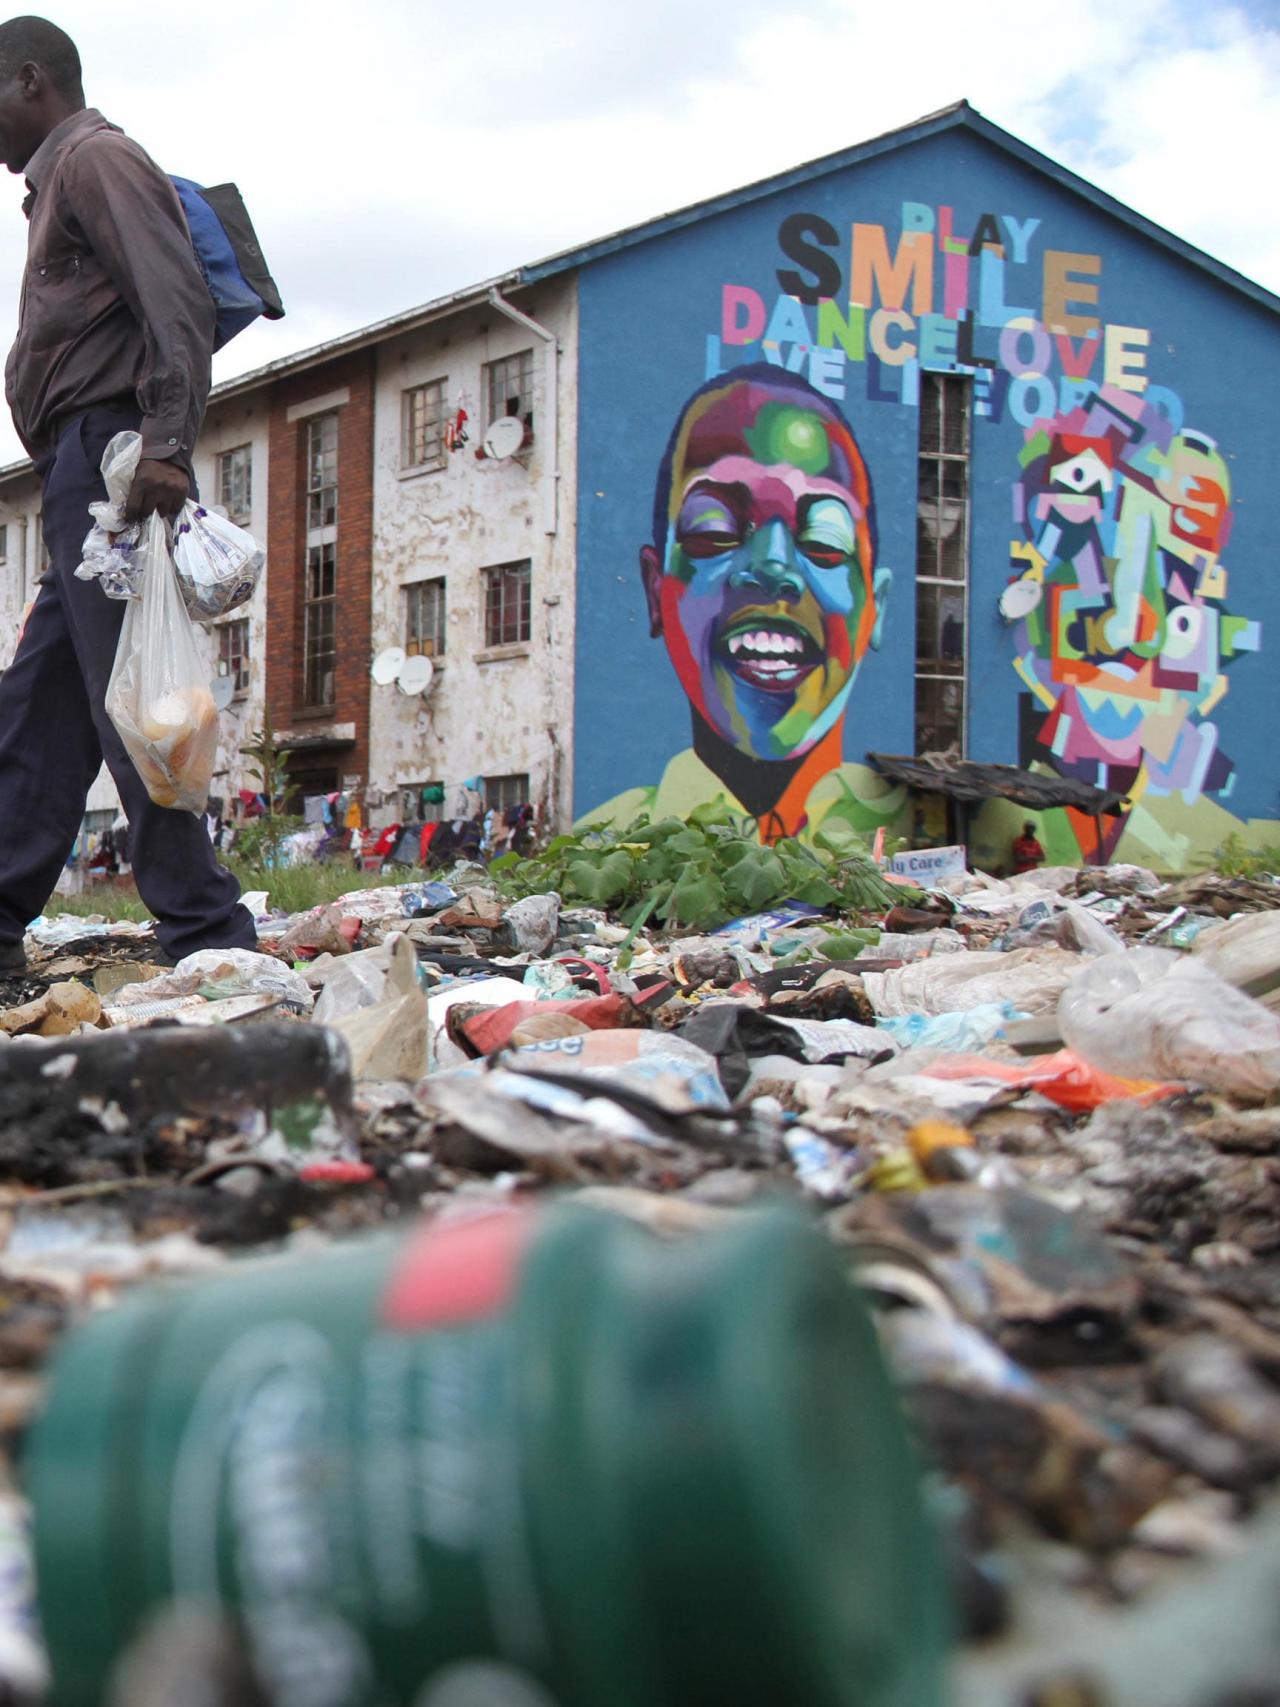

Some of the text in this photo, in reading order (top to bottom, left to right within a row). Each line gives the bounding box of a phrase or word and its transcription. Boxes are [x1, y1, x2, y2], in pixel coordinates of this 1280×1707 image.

[775, 212, 1101, 338] SMILE
[902, 201, 1041, 264] PLAY
[722, 284, 1151, 393] DANCE LOVE
[909, 857, 942, 871] Care
